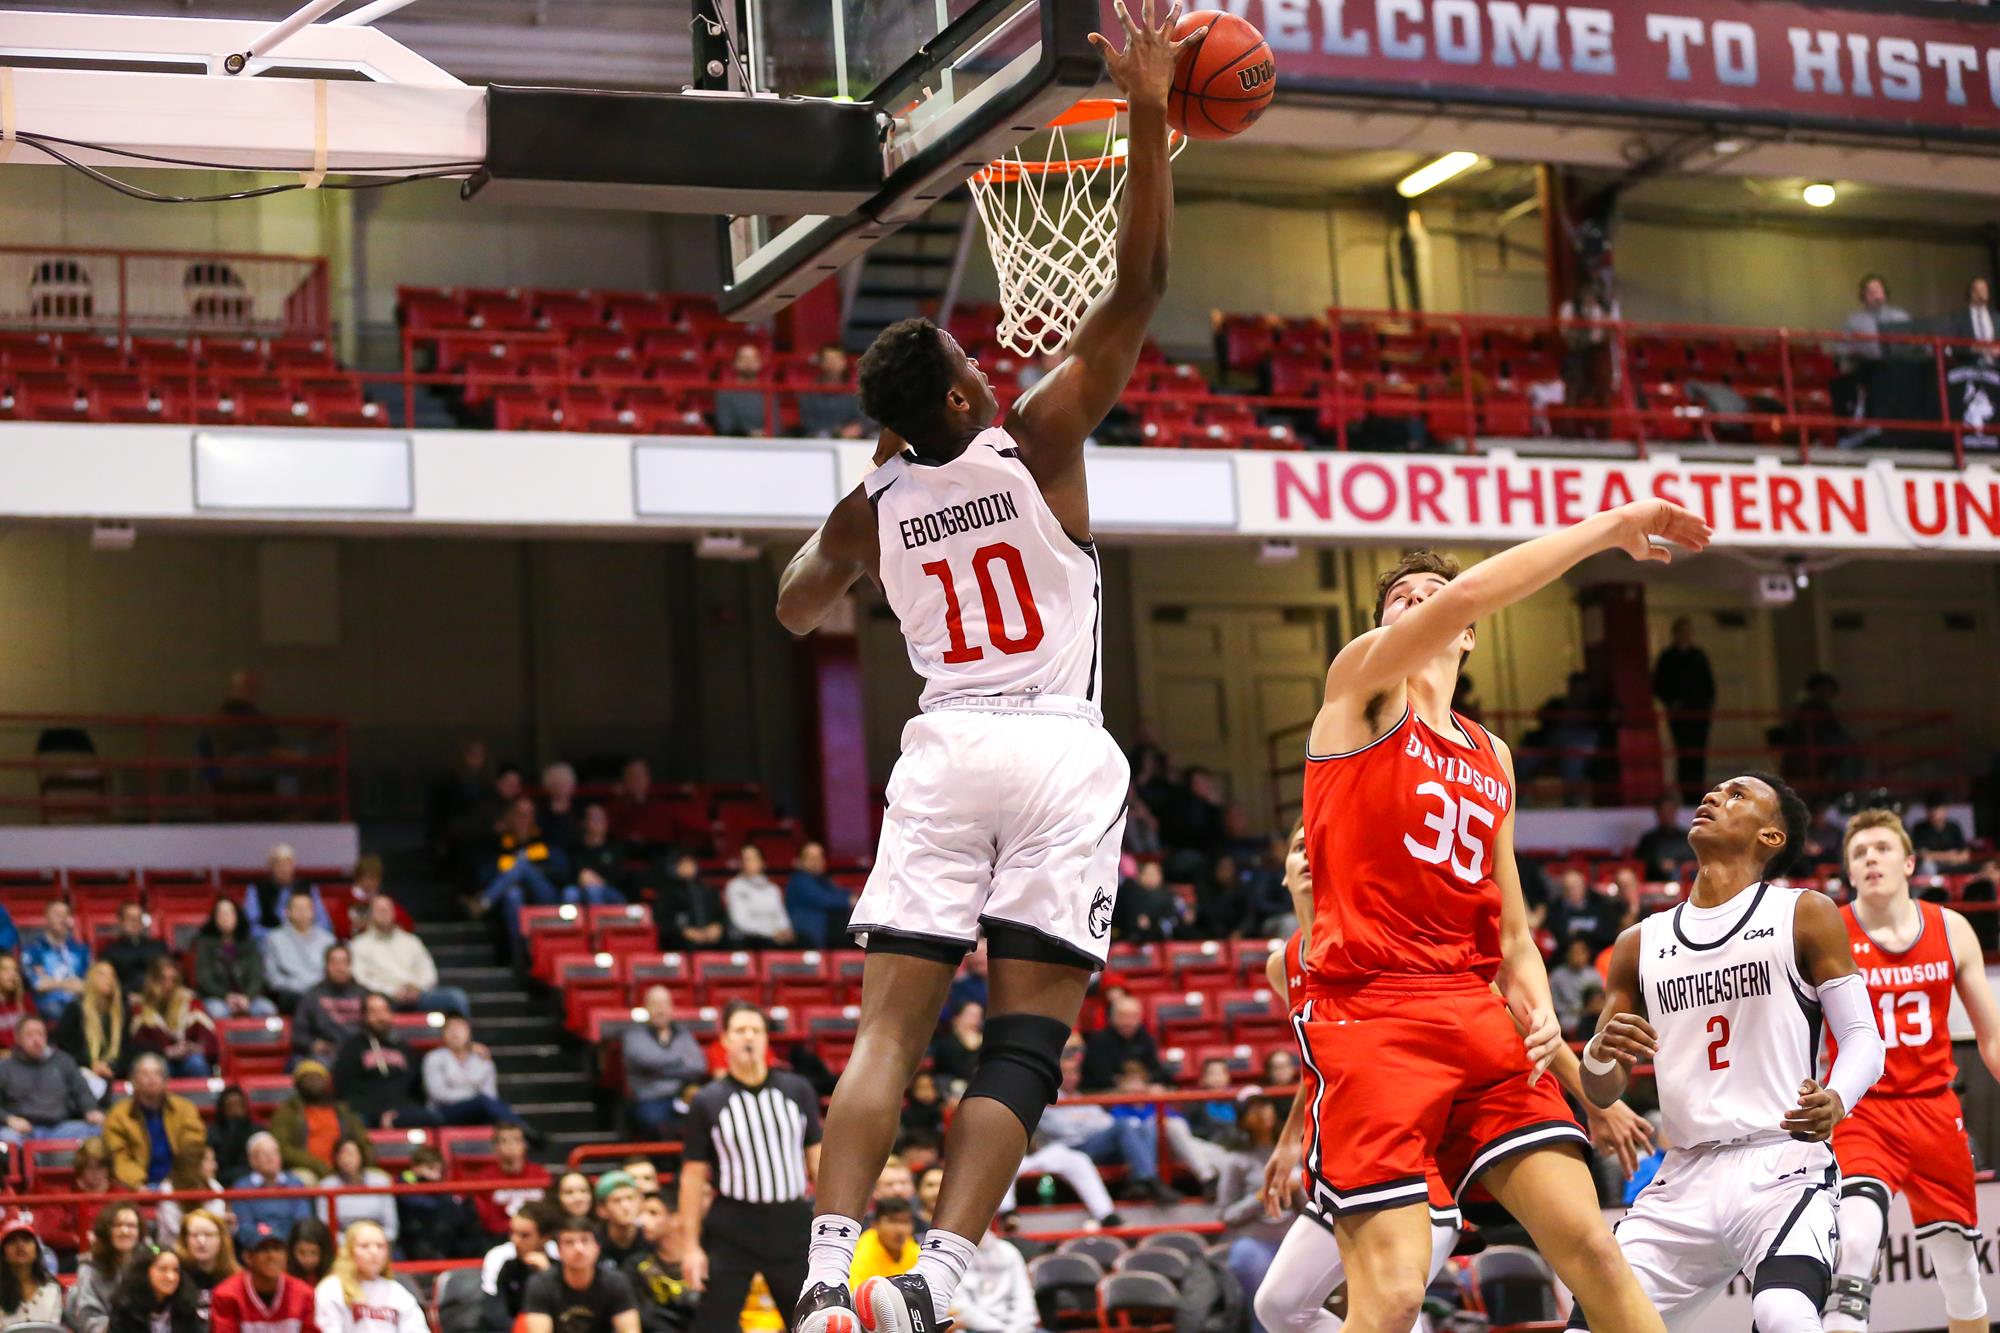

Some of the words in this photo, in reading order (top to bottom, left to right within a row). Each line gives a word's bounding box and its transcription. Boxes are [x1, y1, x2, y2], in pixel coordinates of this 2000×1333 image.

[1168, 0, 1616, 75] ELCOME
[1646, 14, 1758, 87] TO
[1904, 480, 2000, 537] UN
[921, 541, 1045, 664] 10
[1405, 732, 1507, 812] DAVIDSON
[1403, 780, 1495, 884] 35
[1743, 927, 1775, 941] CAA
[1656, 961, 1771, 1015] NORTHEASTERN
[1859, 960, 1949, 987] DAVIDSON
[1706, 1015, 1730, 1071] 2
[1878, 990, 1933, 1049] 13
